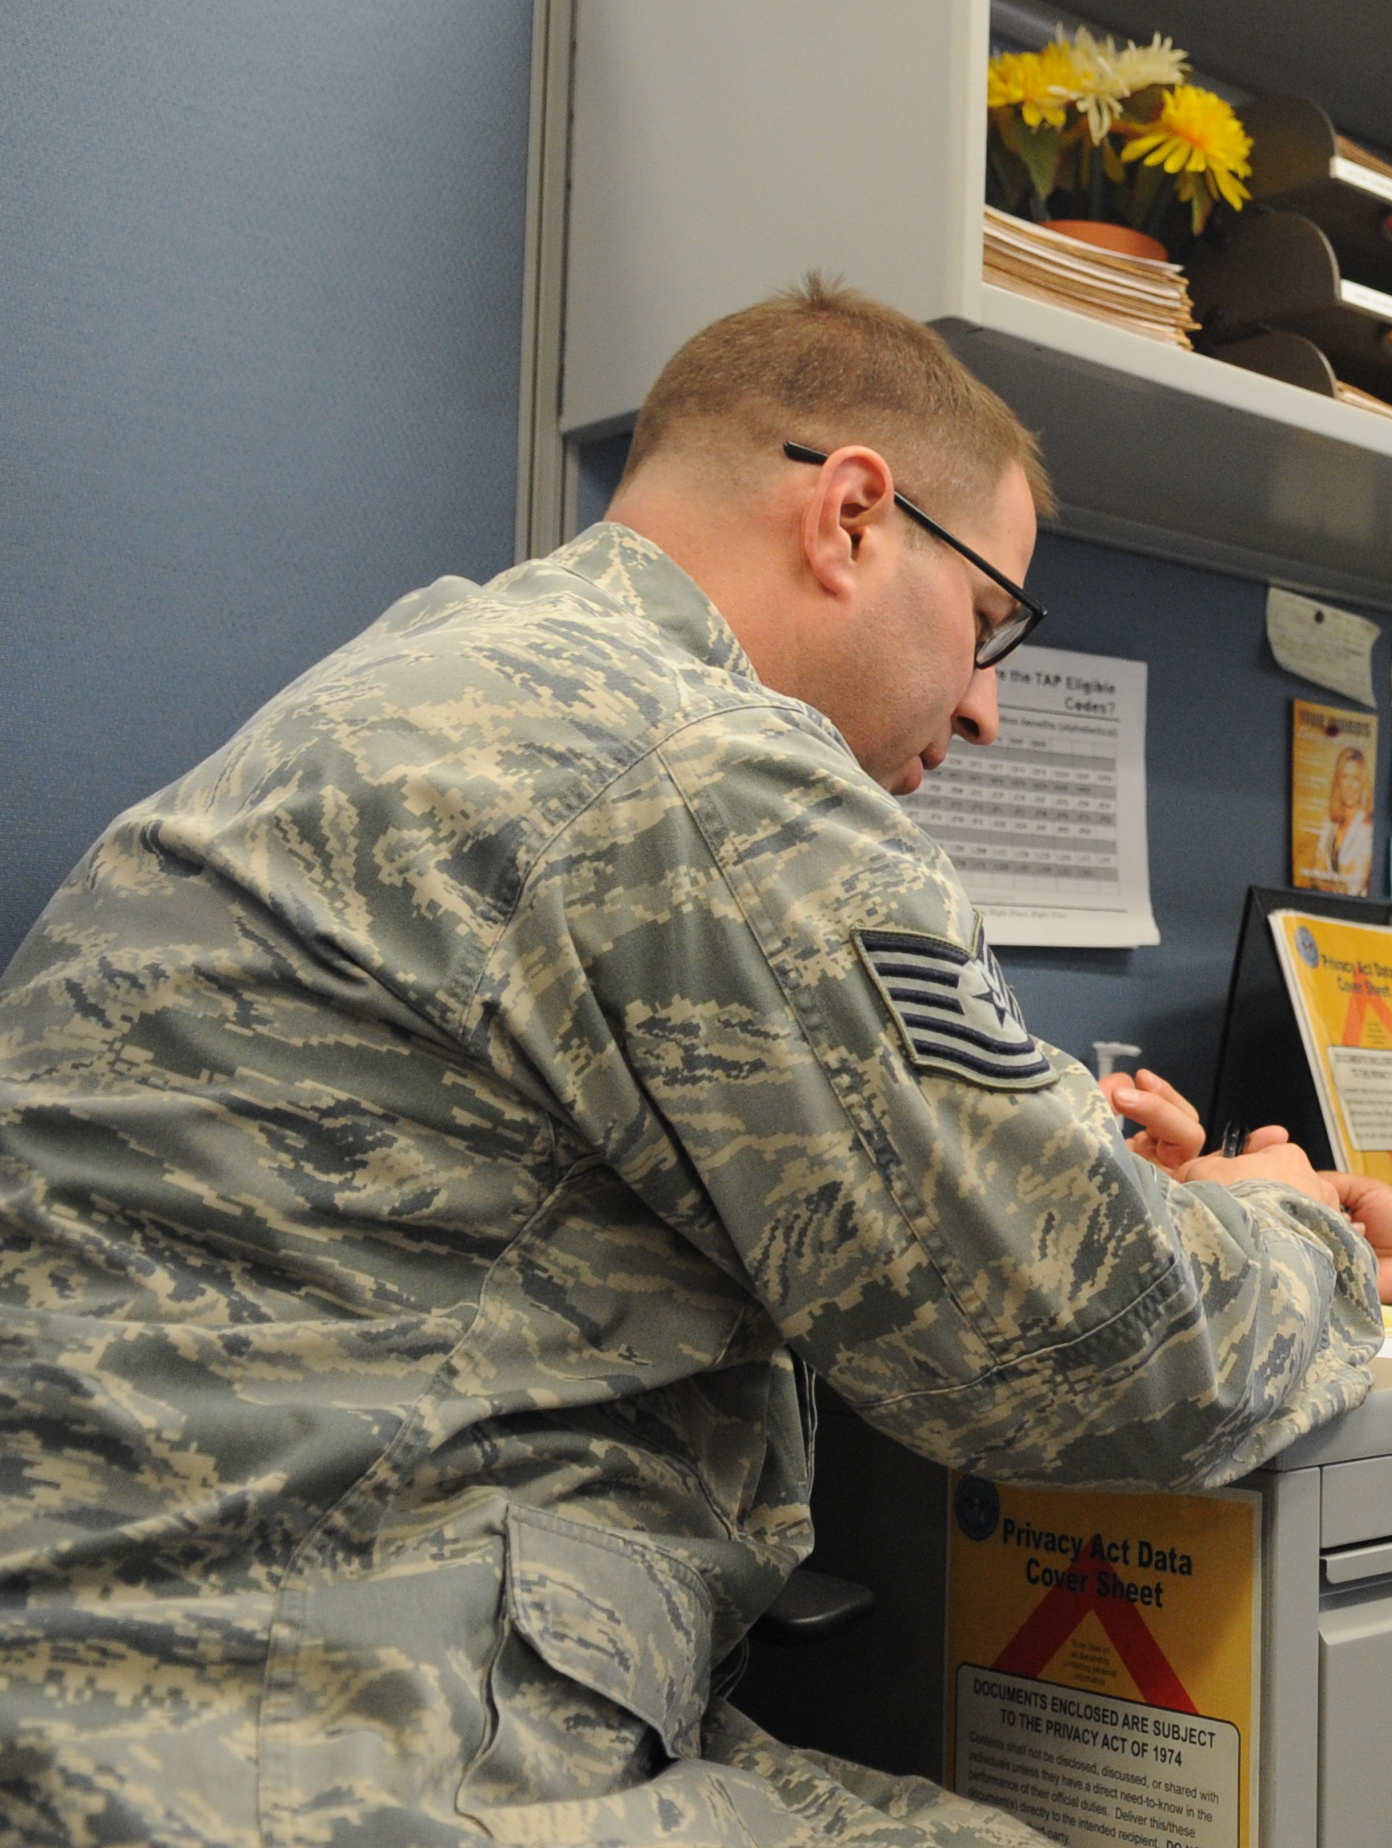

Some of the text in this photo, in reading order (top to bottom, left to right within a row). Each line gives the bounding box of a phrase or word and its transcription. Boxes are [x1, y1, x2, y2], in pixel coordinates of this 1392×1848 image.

[1035, 672, 1061, 687] TAP
[1066, 677, 1116, 695] Eligible
[1065, 697, 1116, 715] Codes?
[1003, 1518, 1193, 1576] Privacy Act Data
[1026, 1557, 1163, 1608] Cover Sheet
[973, 1678, 1216, 1748] DOCUMENTS ENCLOSED ARE SUBJECT
[1000, 1708, 1182, 1767] TO THE PRIVACY ACT OF 1974
[1011, 1763, 1040, 1779] unless
[1041, 1768, 1060, 1786] they
[1061, 1774, 1083, 1790] have
[1084, 1782, 1092, 1792] a
[1093, 1782, 1118, 1800] direct
[1120, 1789, 1184, 1815] need-to-know
[1186, 1804, 1195, 1818] in
[1197, 1808, 1213, 1823] the
[1027, 1747, 1042, 1760] not
[1043, 1751, 1055, 1763] be
[1056, 1754, 1099, 1775] disclosed,
[1101, 1765, 1150, 1788] discussed,
[1152, 1779, 1163, 1790] or
[1164, 1781, 1198, 1799] shared
[1199, 1789, 1219, 1804] with
[1019, 1801, 1051, 1822] directly
[1051, 1809, 1062, 1823] to
[1062, 1812, 1077, 1827] the
[1078, 1815, 1116, 1838] intended
[1118, 1828, 1159, 1848] recipient.
[1020, 1783, 1030, 1795] of
[1030, 1785, 1050, 1801] their
[1051, 1790, 1079, 1808] official
[1115, 1806, 1148, 1826] Deliver
[1149, 1816, 1196, 1839] this/these
